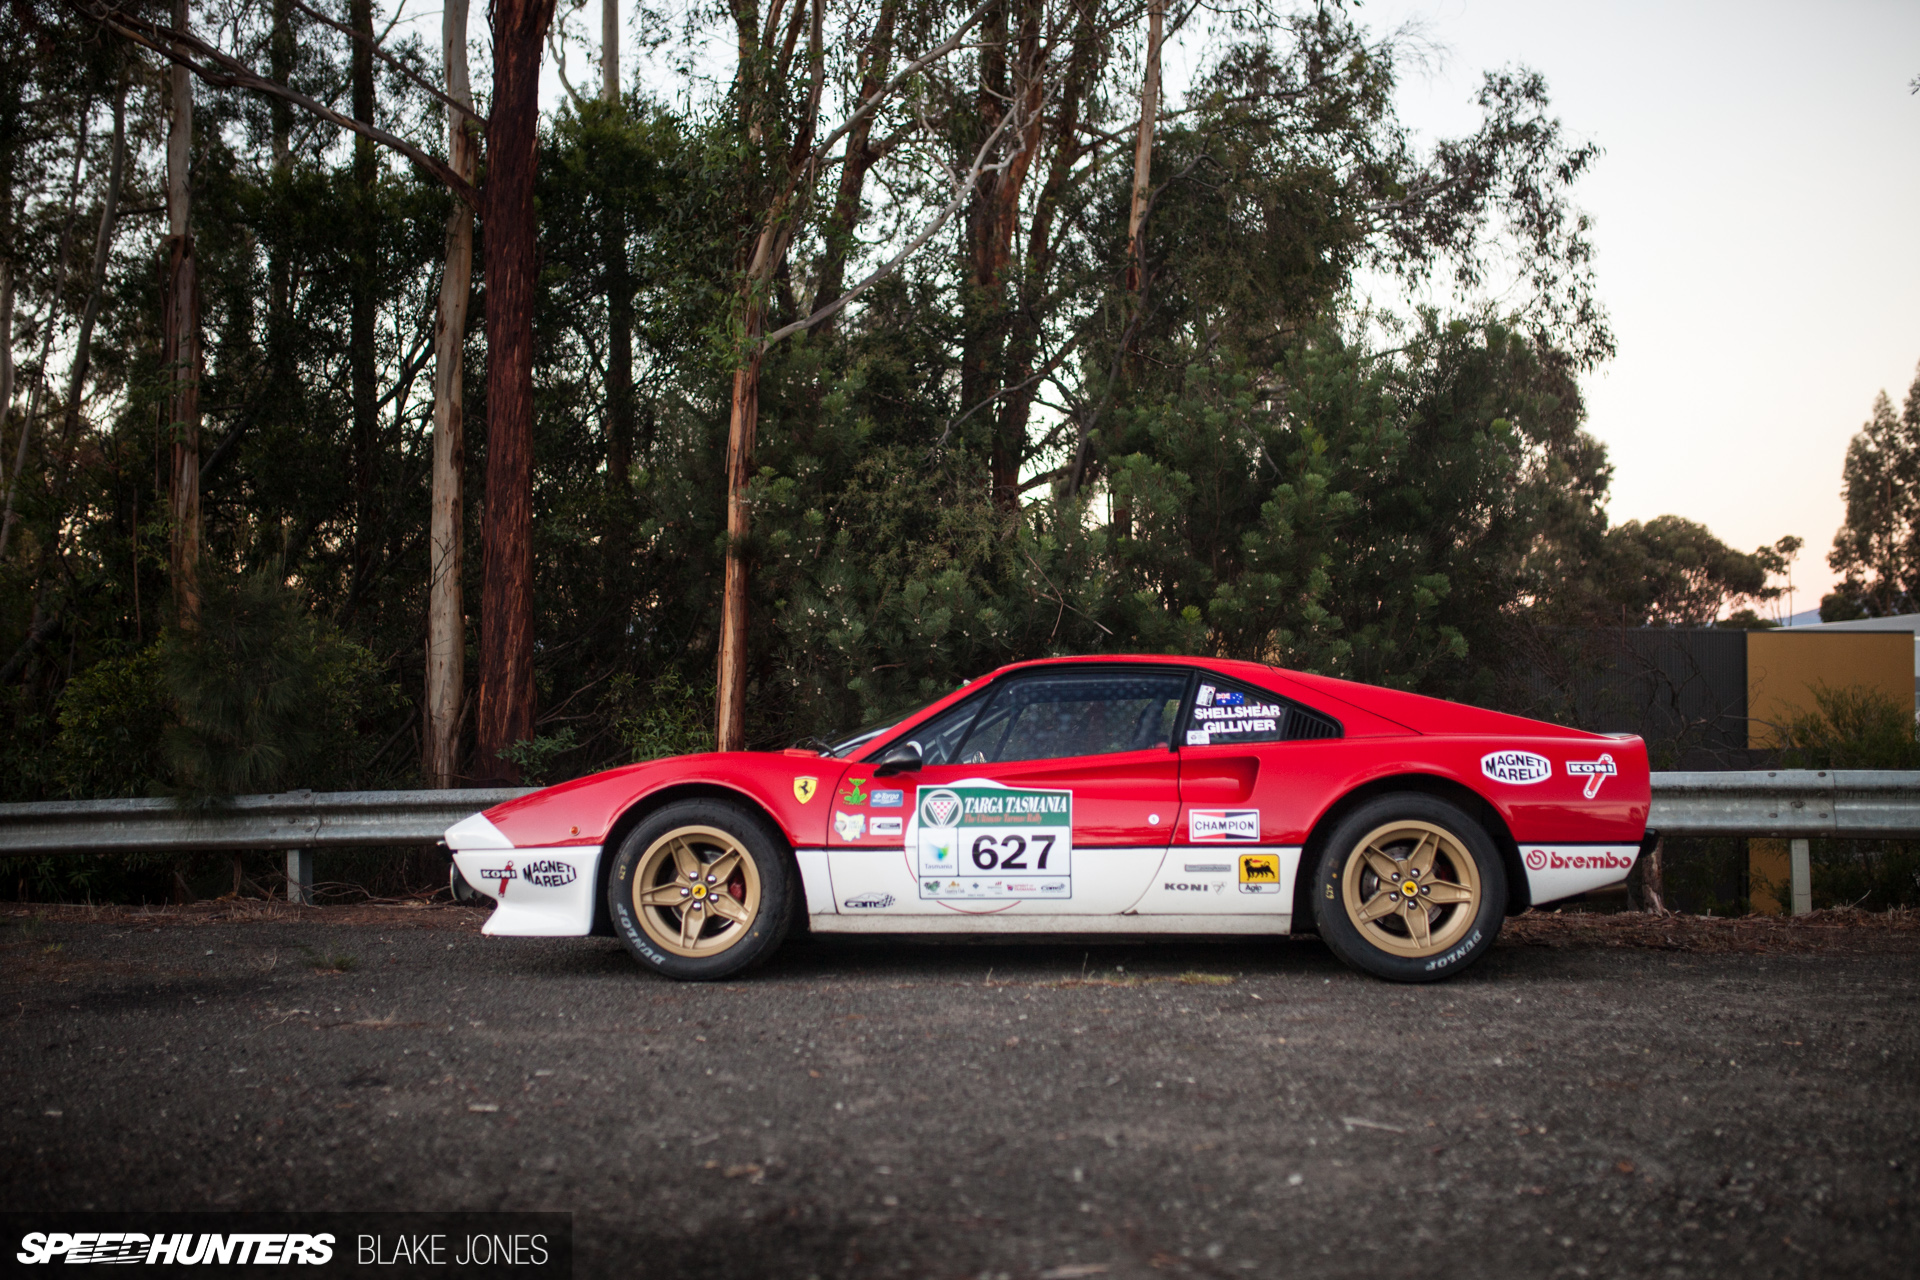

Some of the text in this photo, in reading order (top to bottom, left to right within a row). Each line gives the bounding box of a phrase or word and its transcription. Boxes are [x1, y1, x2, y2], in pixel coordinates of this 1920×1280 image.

[1194, 705, 1281, 719] SHELLSHEAR
[1203, 719, 1276, 733] GILLIVER
[1485, 754, 1548, 772] MAGNETI
[1570, 764, 1613, 773] KONI
[1486, 764, 1548, 781] MARELLI
[964, 796, 1067, 814] TARGA TASMANIA
[1195, 821, 1254, 830] CHAMPION
[971, 834, 1056, 870] 627
[1550, 851, 1632, 869] brembo
[482, 870, 516, 878] KONI
[523, 860, 577, 877] MAGNETI
[1164, 883, 1209, 892] KONI
[1245, 883, 1262, 892] Agip
[617, 903, 666, 965] DUNLOP
[1425, 929, 1483, 971] DUNLOP
